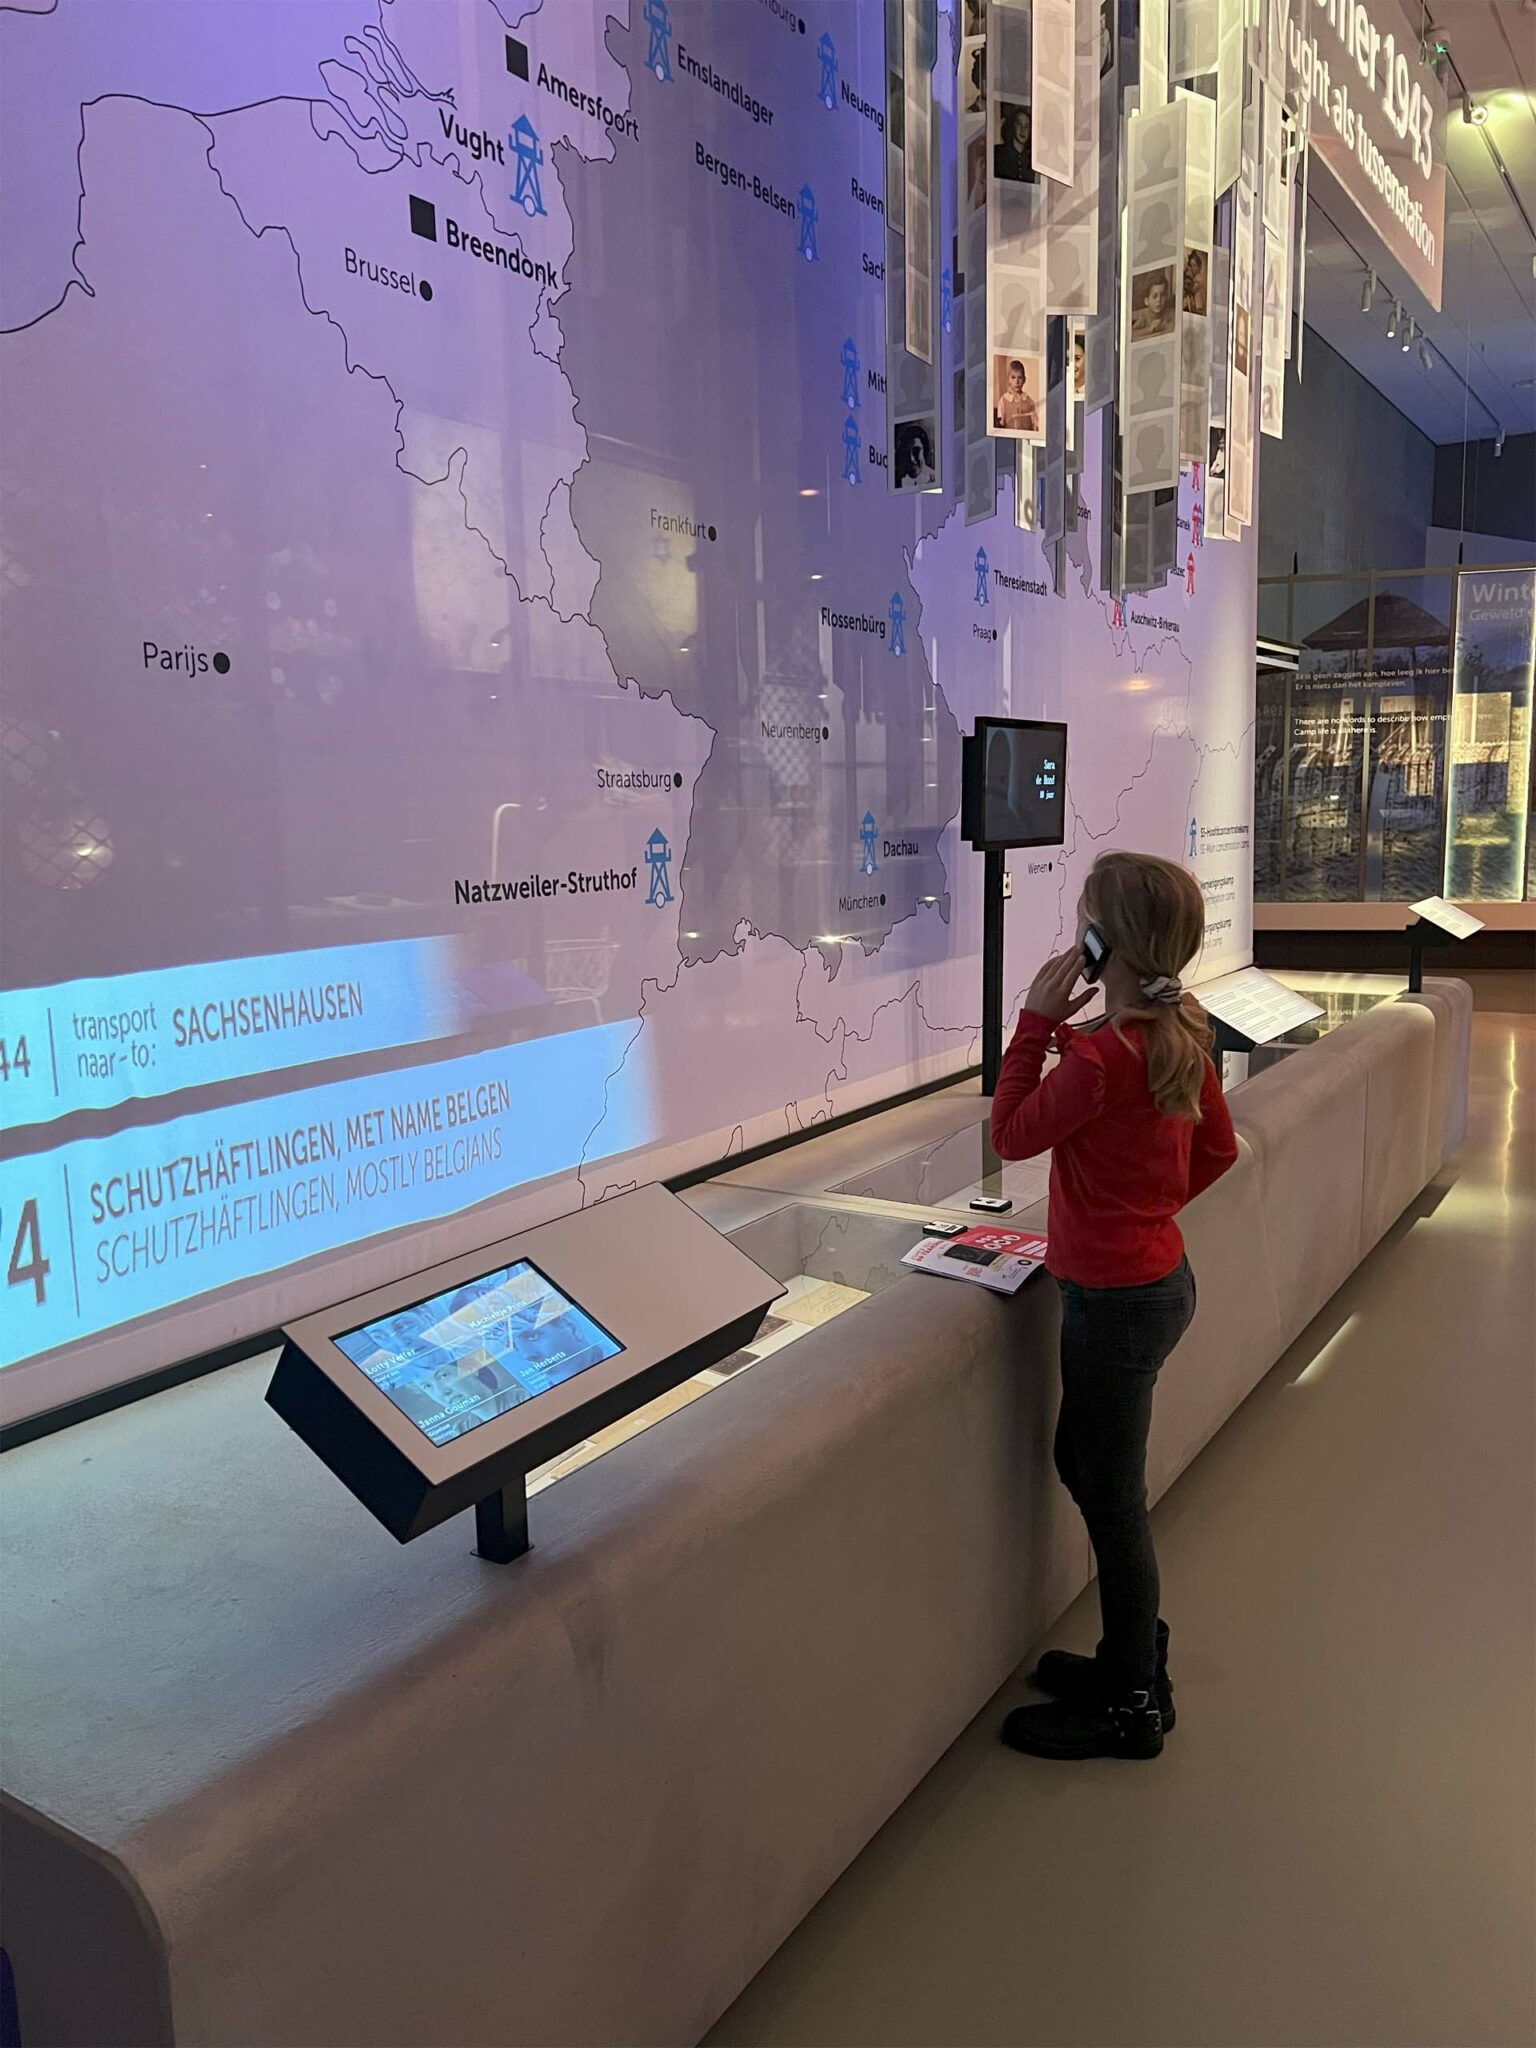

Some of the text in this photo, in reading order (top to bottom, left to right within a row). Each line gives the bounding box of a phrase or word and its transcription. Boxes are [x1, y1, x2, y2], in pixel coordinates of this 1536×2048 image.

[536, 62, 640, 142] Amersfoort
[677, 44, 774, 127] Emslandlager
[1382, 33, 1434, 180] 1943
[438, 106, 505, 166] Vught
[695, 141, 796, 219] Bergen-Belsen
[1331, 85, 1355, 150] als
[1356, 113, 1435, 268] tussenstation
[345, 247, 417, 297] Brussel
[446, 217, 558, 290] Breendonk
[650, 508, 706, 541] Frankfurt
[994, 568, 1048, 596] Theresienstadt
[821, 606, 886, 639] Flossenbürg
[972, 623, 992, 641] Praag
[143, 642, 209, 678] Parijs
[761, 720, 820, 743] Neurenberg
[597, 768, 672, 793] Straatsburg
[883, 840, 919, 859] Dachau
[1028, 862, 1048, 876] Wenen
[454, 868, 637, 905] Natzweiler-Struthof
[839, 894, 879, 912] München
[73, 1002, 158, 1043] transport
[173, 981, 364, 1048] SACHSENHAUSEN
[90, 1079, 511, 1224] SCHUTZHÄFTLINGEN, MET NAME BELGEN
[96, 1127, 503, 1284] SCHUTZHÄFTLINGEN, MOSTLY BELGIANS
[417, 1411, 446, 1428] Janna
